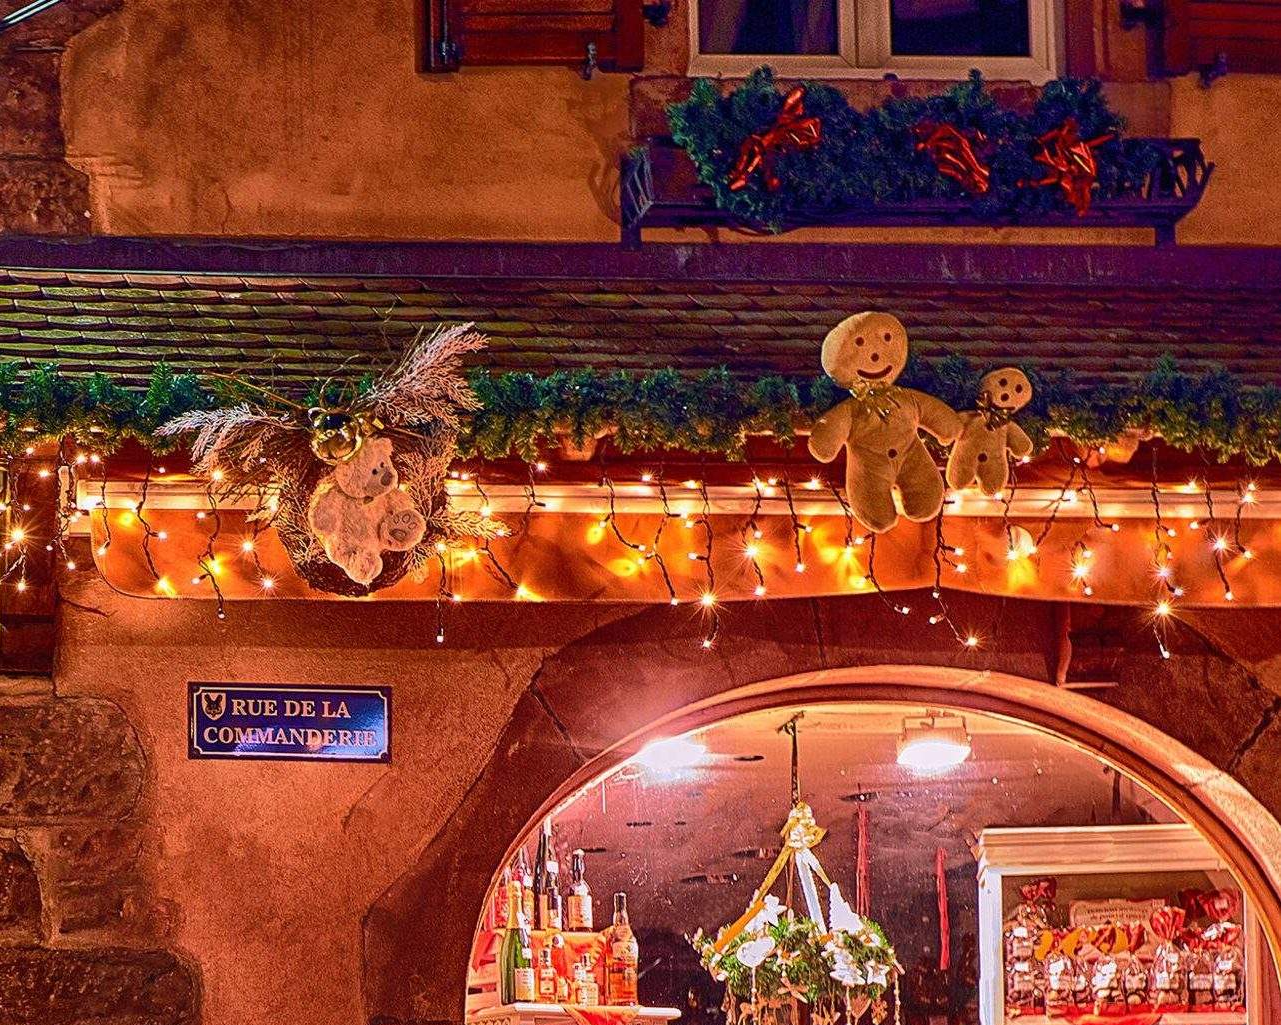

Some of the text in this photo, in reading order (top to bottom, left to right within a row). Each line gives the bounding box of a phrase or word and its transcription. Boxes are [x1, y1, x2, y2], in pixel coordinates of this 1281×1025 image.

[231, 699, 351, 718] RUE DE LA
[203, 726, 377, 747] COMMANDERIE
